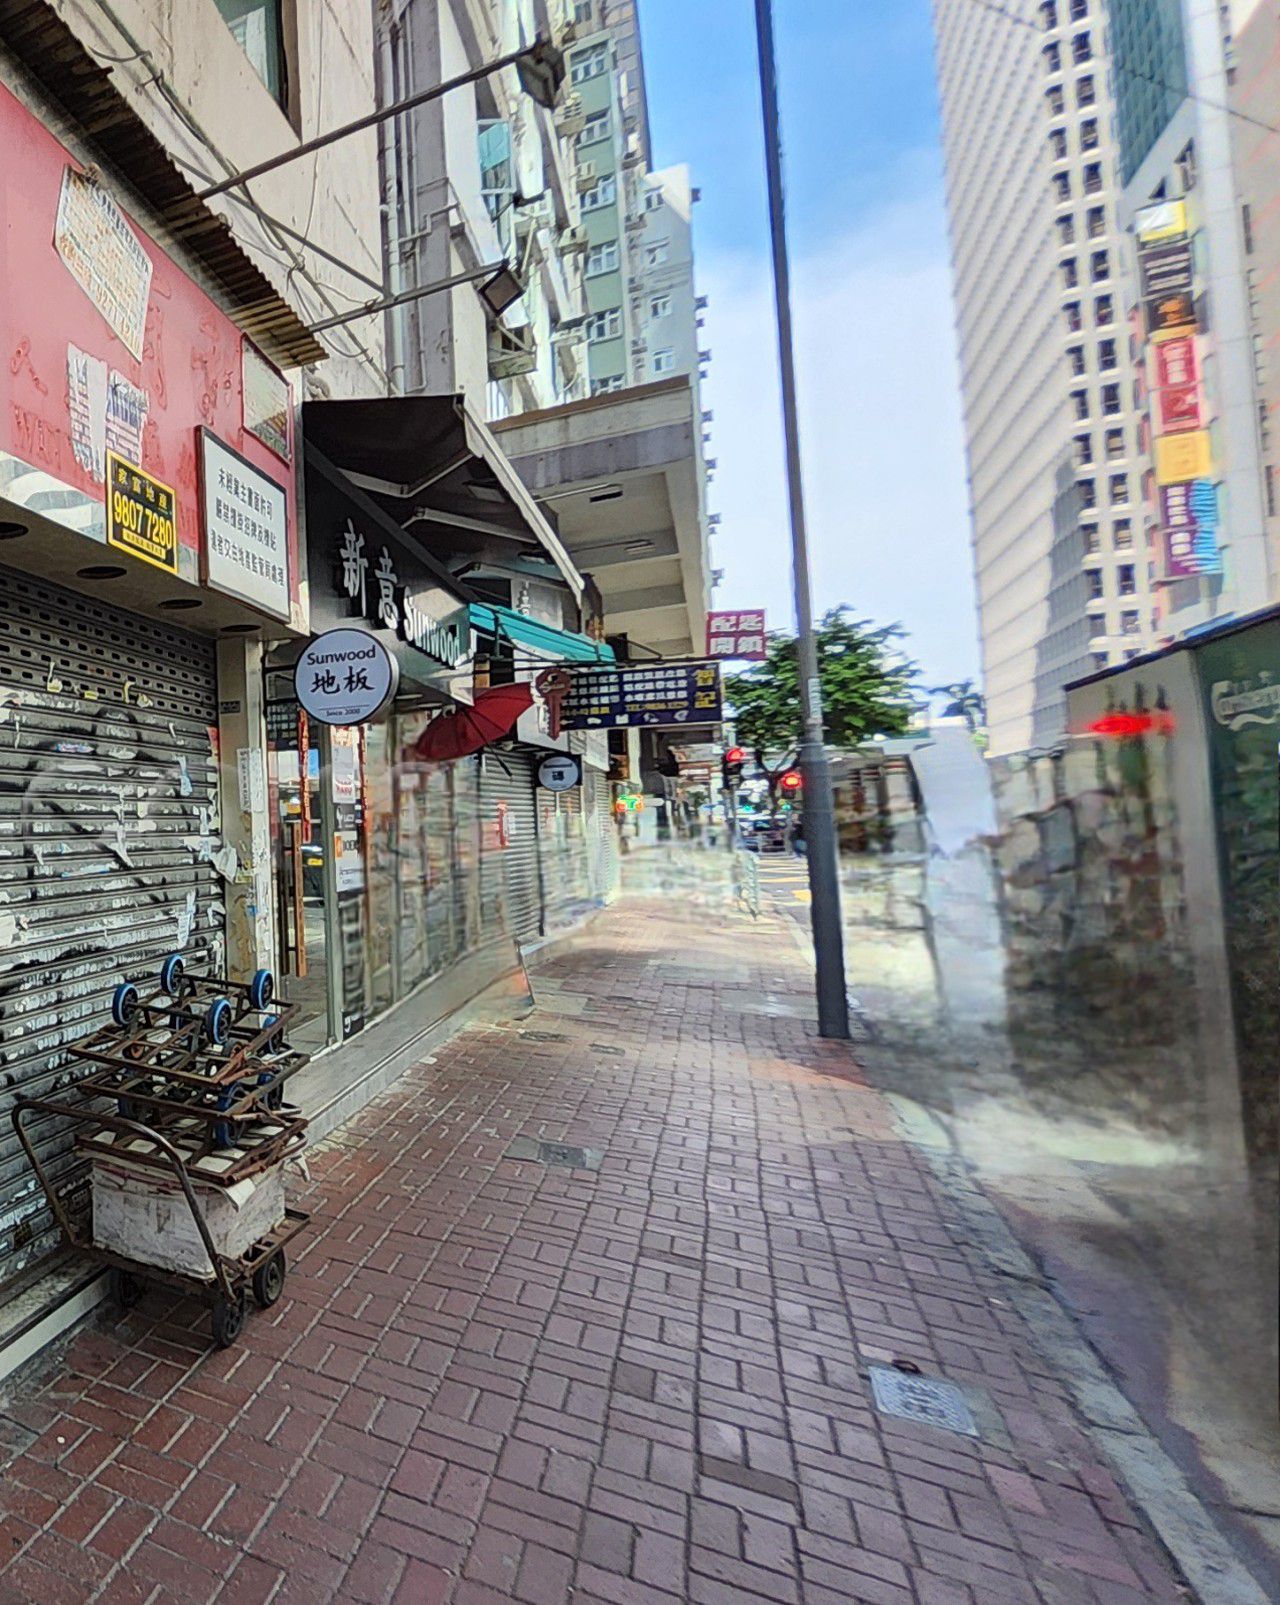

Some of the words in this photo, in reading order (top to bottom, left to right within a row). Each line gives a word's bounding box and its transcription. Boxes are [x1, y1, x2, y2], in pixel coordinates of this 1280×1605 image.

[114, 491, 143, 534] 9807
[145, 509, 172, 550] 7280
[339, 518, 399, 629] 新意
[307, 645, 375, 665] Sunwood
[404, 586, 461, 667] Sunwood
[311, 666, 375, 694] 地板
